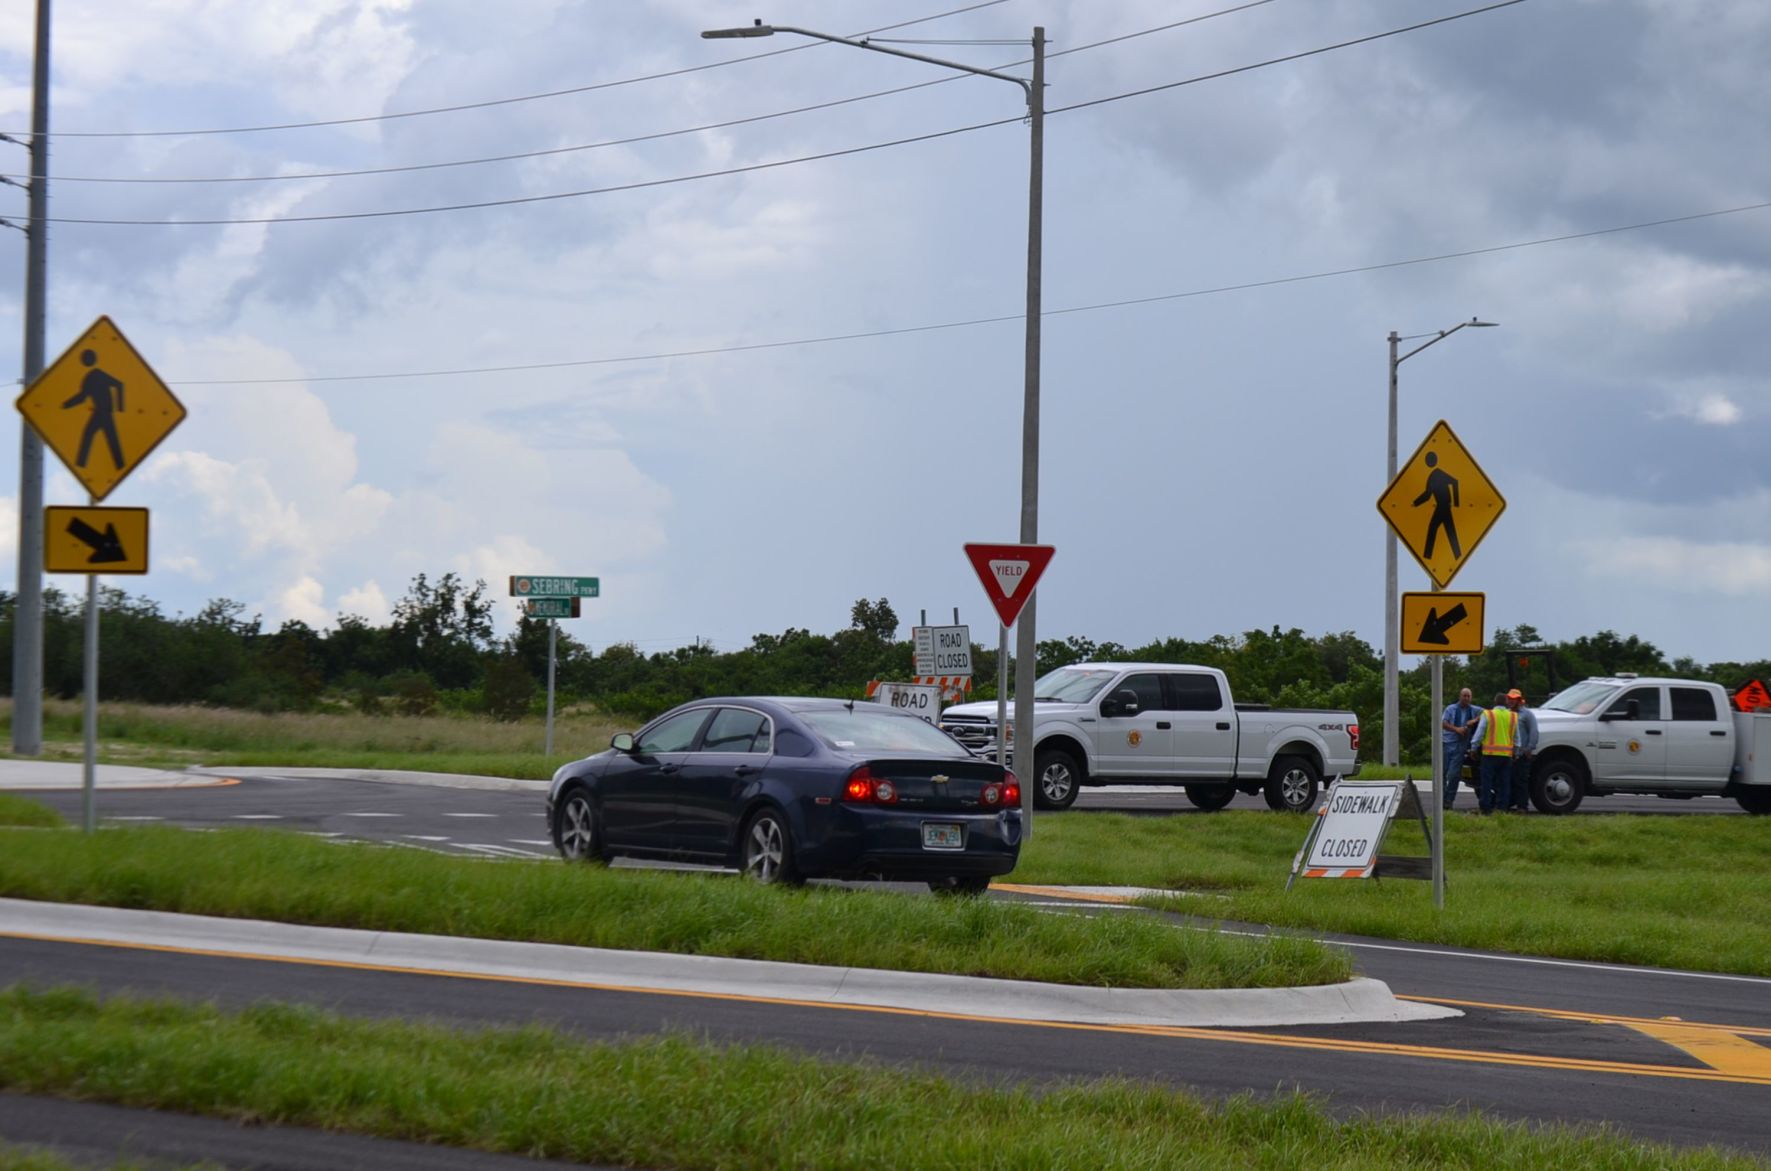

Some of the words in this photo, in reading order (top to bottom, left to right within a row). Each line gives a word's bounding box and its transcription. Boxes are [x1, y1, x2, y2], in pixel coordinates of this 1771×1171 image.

[995, 565, 1023, 577] YIELD
[531, 578, 579, 595] SEBRING
[940, 633, 962, 648] ROAD
[937, 653, 968, 669] CLOSED
[891, 692, 928, 709] ROAD
[1332, 795, 1390, 814] SIDEWALK
[1321, 839, 1368, 858] CLOSED
